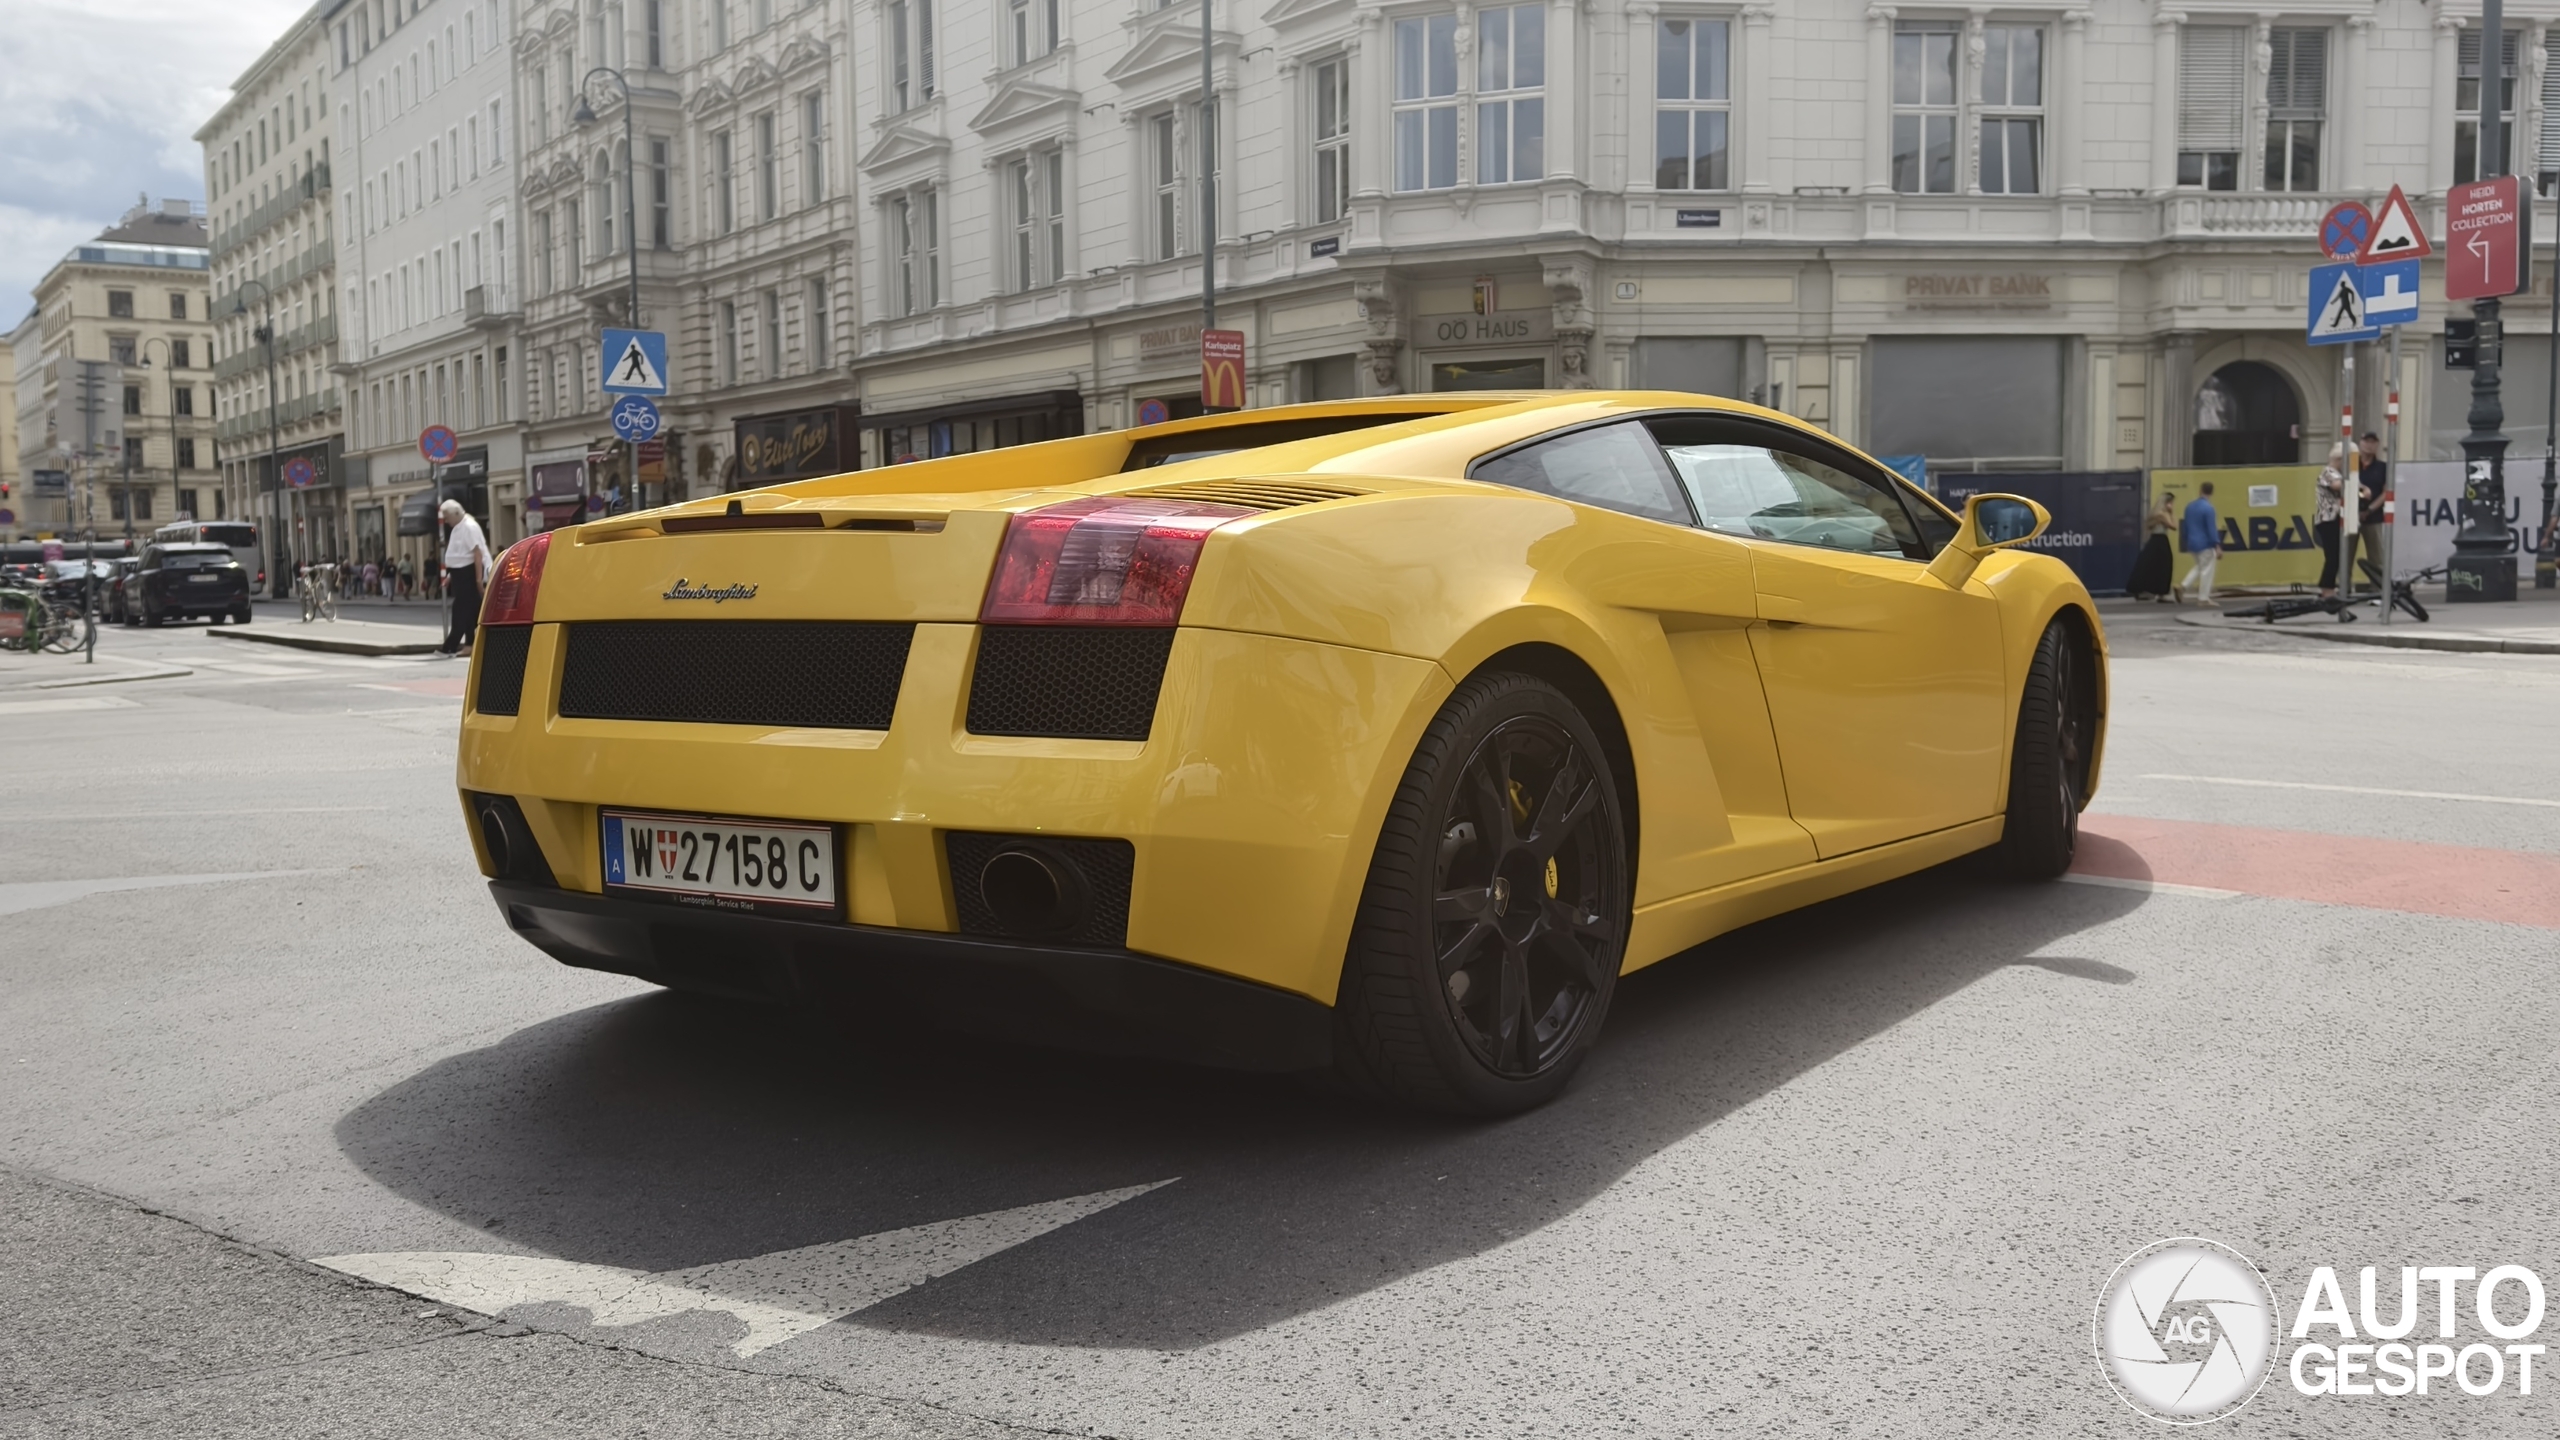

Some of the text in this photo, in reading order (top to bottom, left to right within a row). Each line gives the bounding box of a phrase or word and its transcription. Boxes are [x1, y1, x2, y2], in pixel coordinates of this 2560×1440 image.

[2470, 186, 2495, 199] HEIDI
[2461, 198, 2503, 215] HORTEN
[2451, 212, 2513, 232] COLLECTION
[1906, 276, 2050, 295] PRIVAT BANK
[1140, 328, 1177, 349] PRIVAT
[1476, 320, 1529, 339] HAUS
[1205, 341, 1241, 351] Karlsplatz
[662, 577, 758, 604] Lamborghini
[612, 858, 621, 874] A
[630, 827, 820, 892] W 27158 C
[680, 895, 715, 906] Lamborghini
[716, 898, 739, 909] Service
